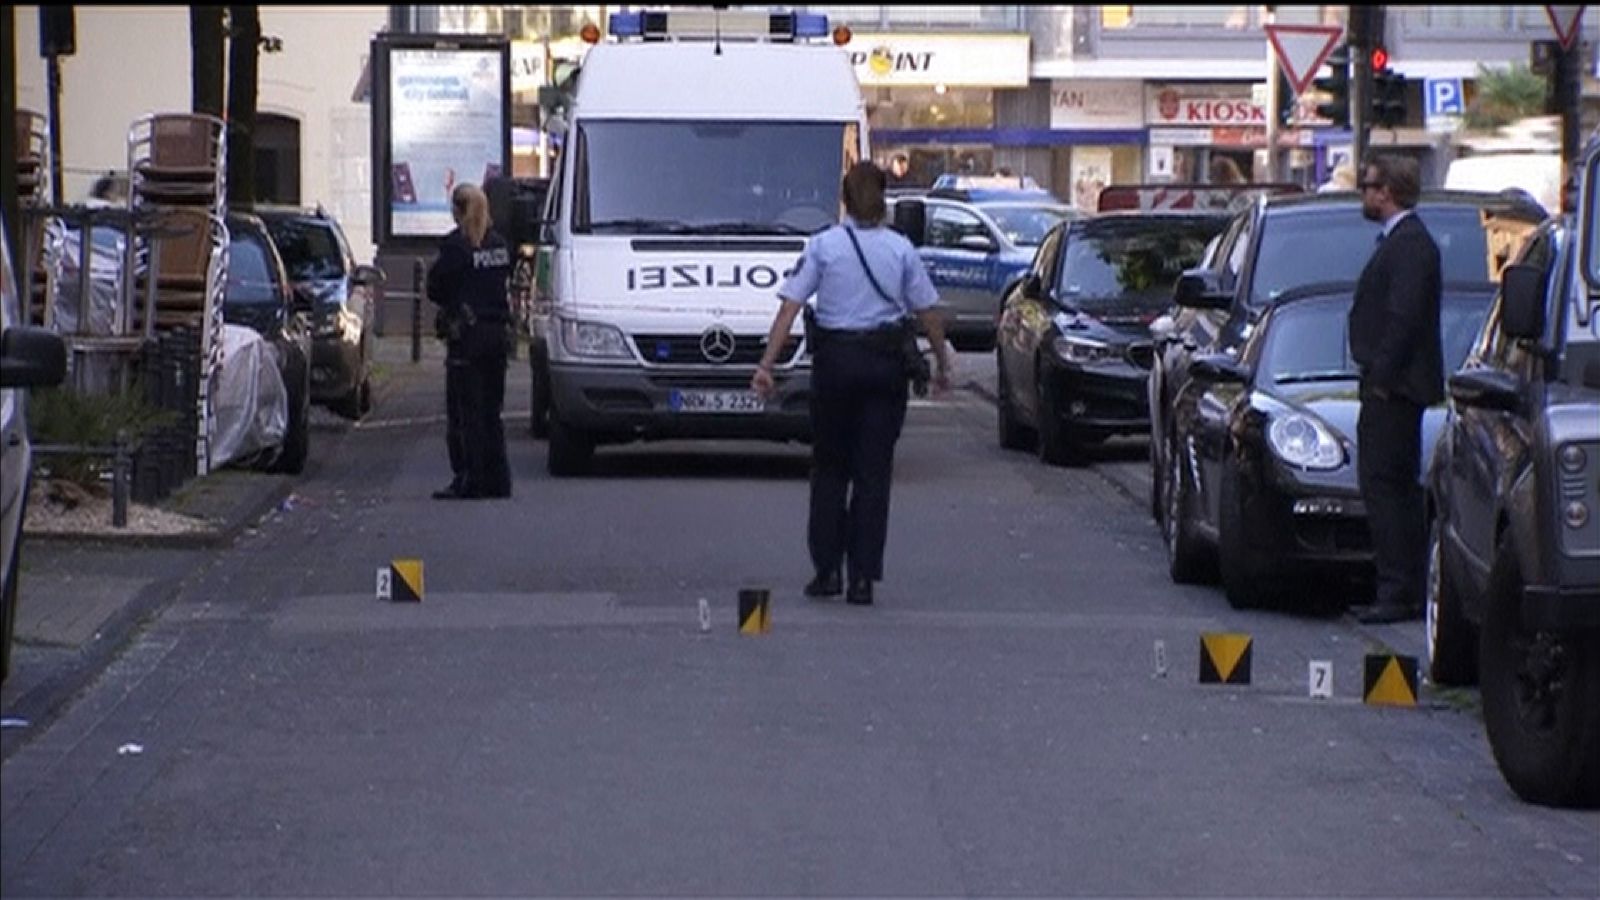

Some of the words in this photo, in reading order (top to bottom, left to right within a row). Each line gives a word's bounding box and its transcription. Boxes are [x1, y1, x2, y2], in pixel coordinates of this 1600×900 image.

[1435, 82, 1455, 113] P
[1187, 102, 1266, 121] KIOSK
[1315, 667, 1327, 689] 7
